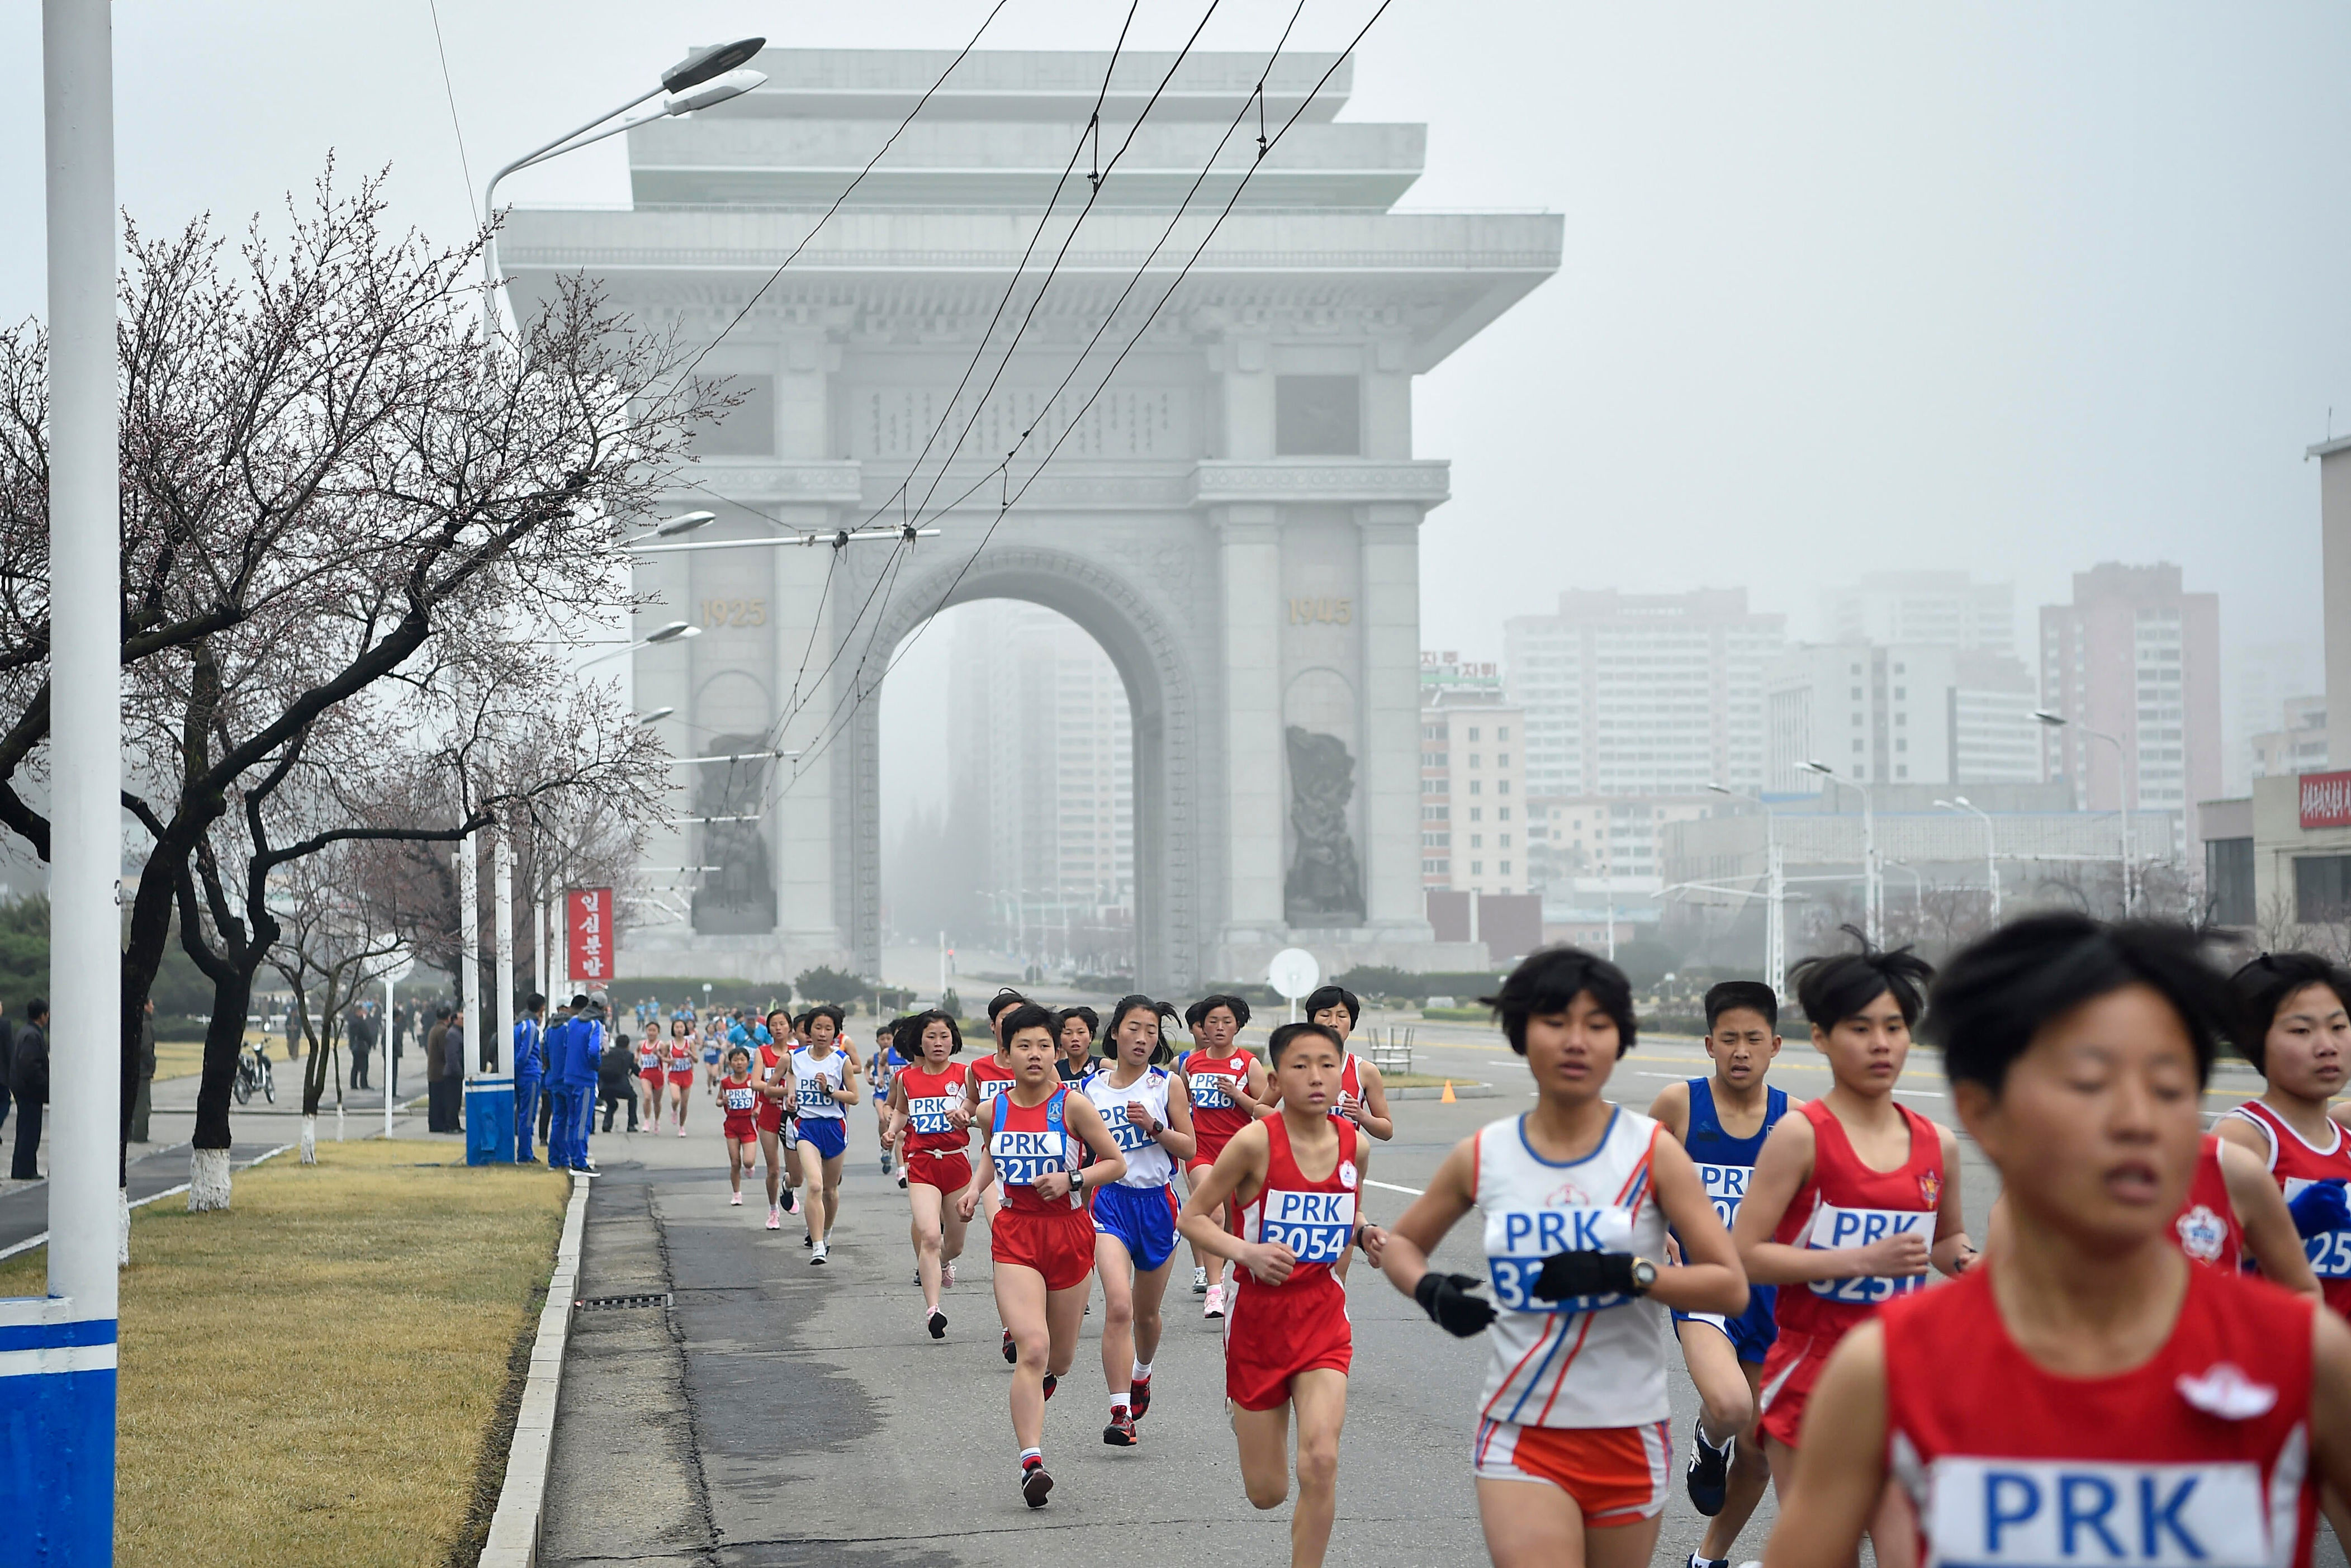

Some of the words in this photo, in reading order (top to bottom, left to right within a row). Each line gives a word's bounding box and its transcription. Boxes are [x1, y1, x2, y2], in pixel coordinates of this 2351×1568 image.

[700, 599, 767, 627] 1925
[1288, 596, 1352, 624] 1945
[801, 1079, 821, 1091] PR
[1196, 1074, 1223, 1088] PR
[728, 1098, 751, 1110] 3239
[729, 1089, 747, 1098] PRK
[797, 1092, 832, 1105] 3216
[914, 1098, 947, 1114] PRK
[1098, 1103, 1132, 1125] PR
[912, 1115, 952, 1133] 3245
[1000, 1134, 1050, 1154] PRK
[994, 1159, 1058, 1183] 3210
[1702, 1167, 1754, 1195] PR
[1281, 1194, 1343, 1222] PRK
[1267, 1224, 1345, 1259] 3054
[1506, 1210, 1605, 1252] PRK
[1983, 1471, 2208, 1560] PRK
